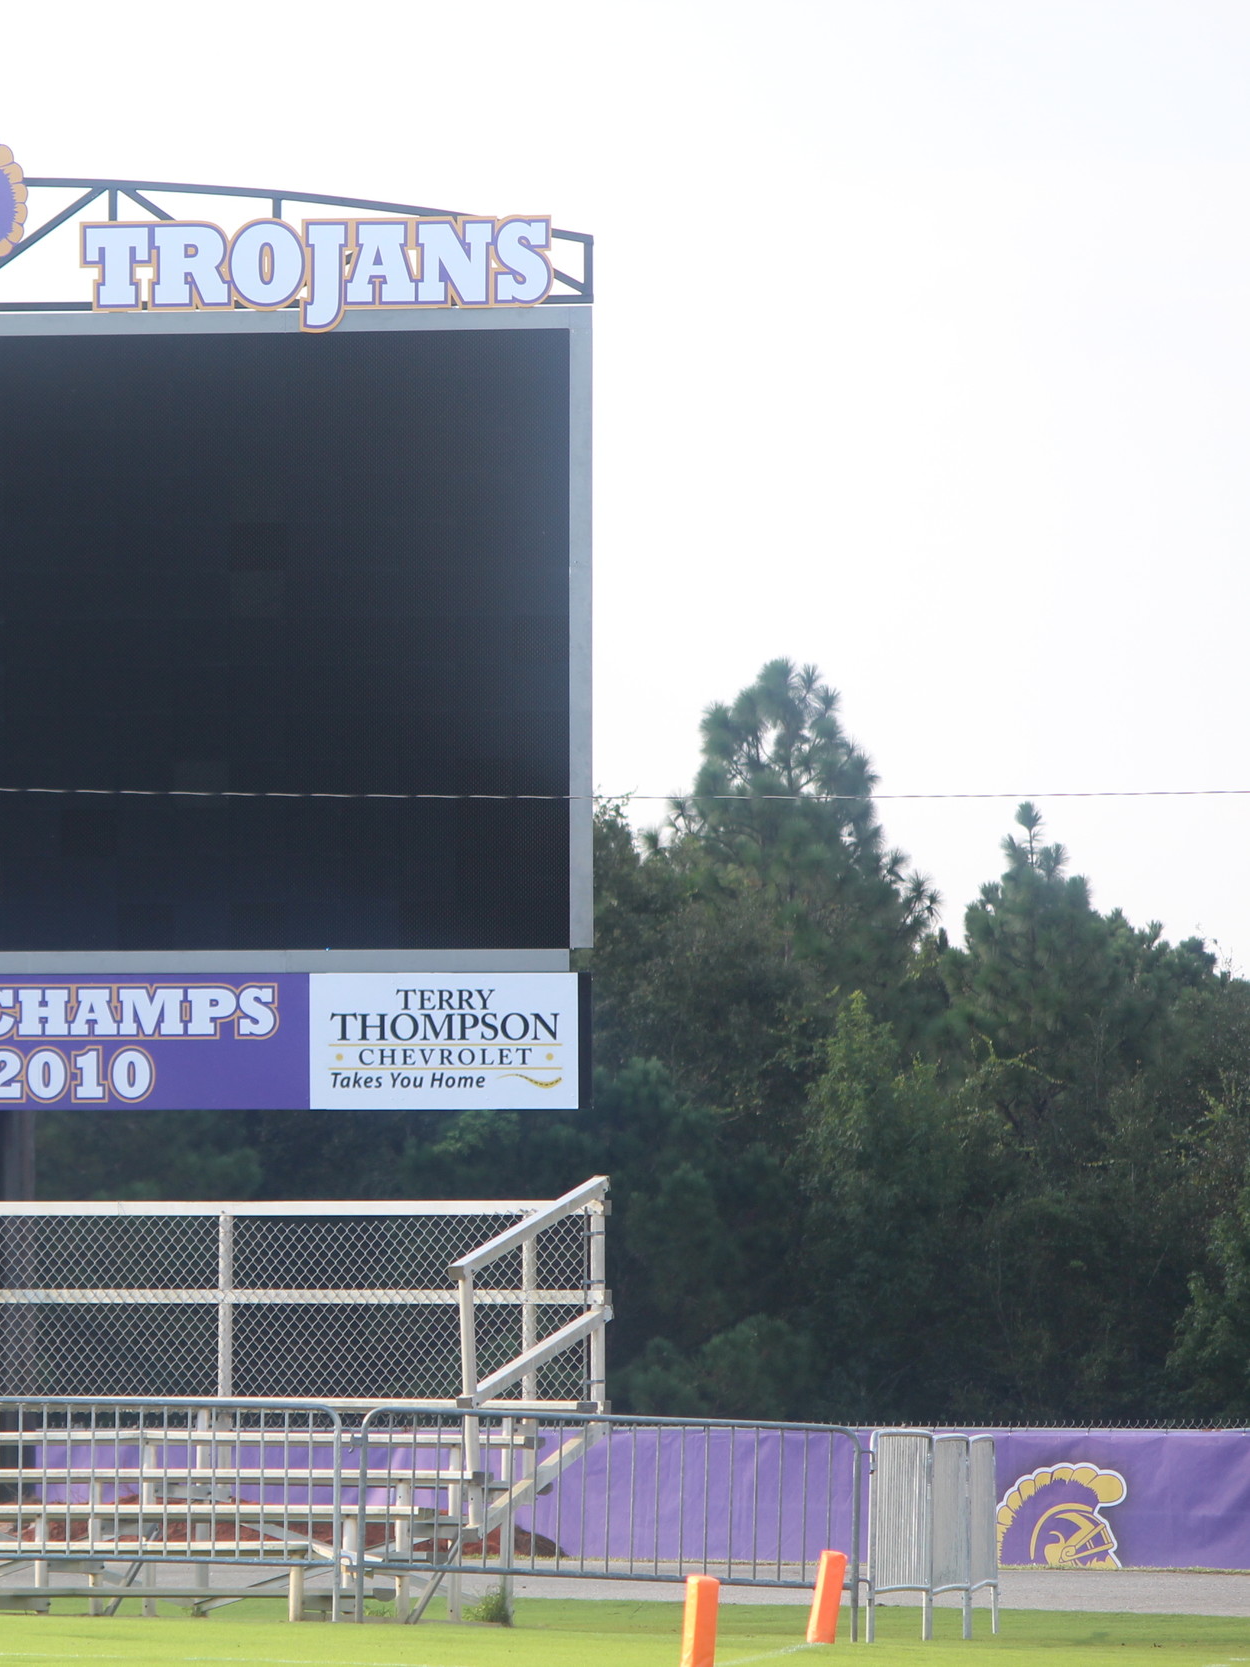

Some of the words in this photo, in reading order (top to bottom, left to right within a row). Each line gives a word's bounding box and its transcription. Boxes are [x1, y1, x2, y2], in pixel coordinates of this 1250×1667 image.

[80, 215, 553, 333] TROJANS
[395, 988, 496, 1011] TERRY
[330, 1012, 560, 1042] THOMPSON
[358, 1048, 533, 1066] CHEVROLET
[330, 1072, 383, 1089] Takes
[390, 1072, 424, 1089] You
[430, 1072, 486, 1089] Home
